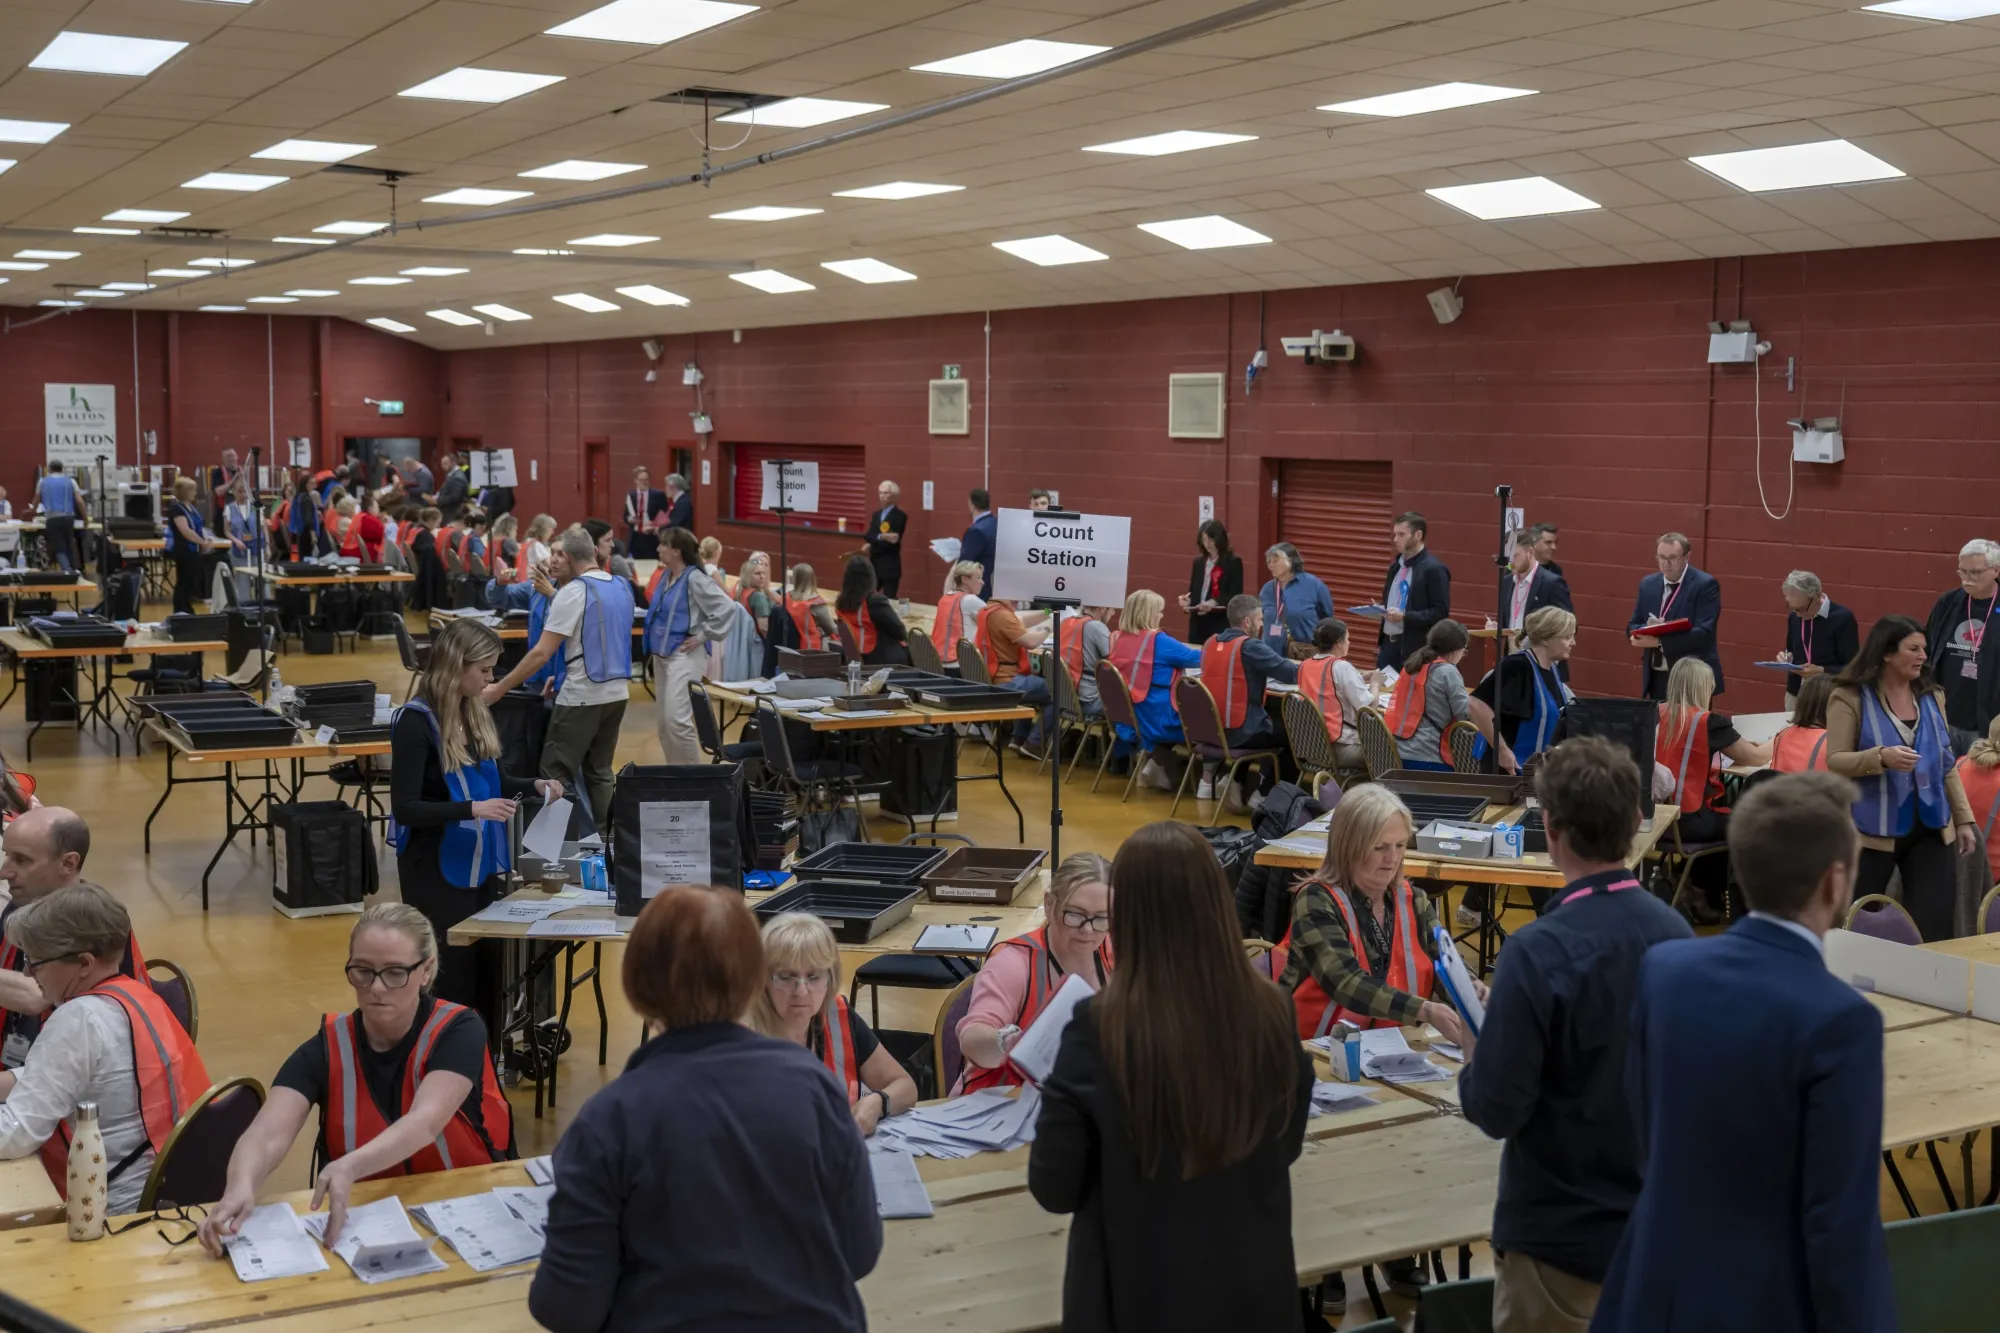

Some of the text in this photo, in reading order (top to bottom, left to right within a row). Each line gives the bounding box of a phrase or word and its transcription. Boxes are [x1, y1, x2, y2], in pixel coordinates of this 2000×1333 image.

[56, 412, 105, 420] HALTON
[48, 433, 115, 445] HALTON
[1034, 521, 1095, 541] Count
[1027, 547, 1097, 568] Station
[1054, 576, 1066, 592] 6
[670, 815, 680, 823] 20
